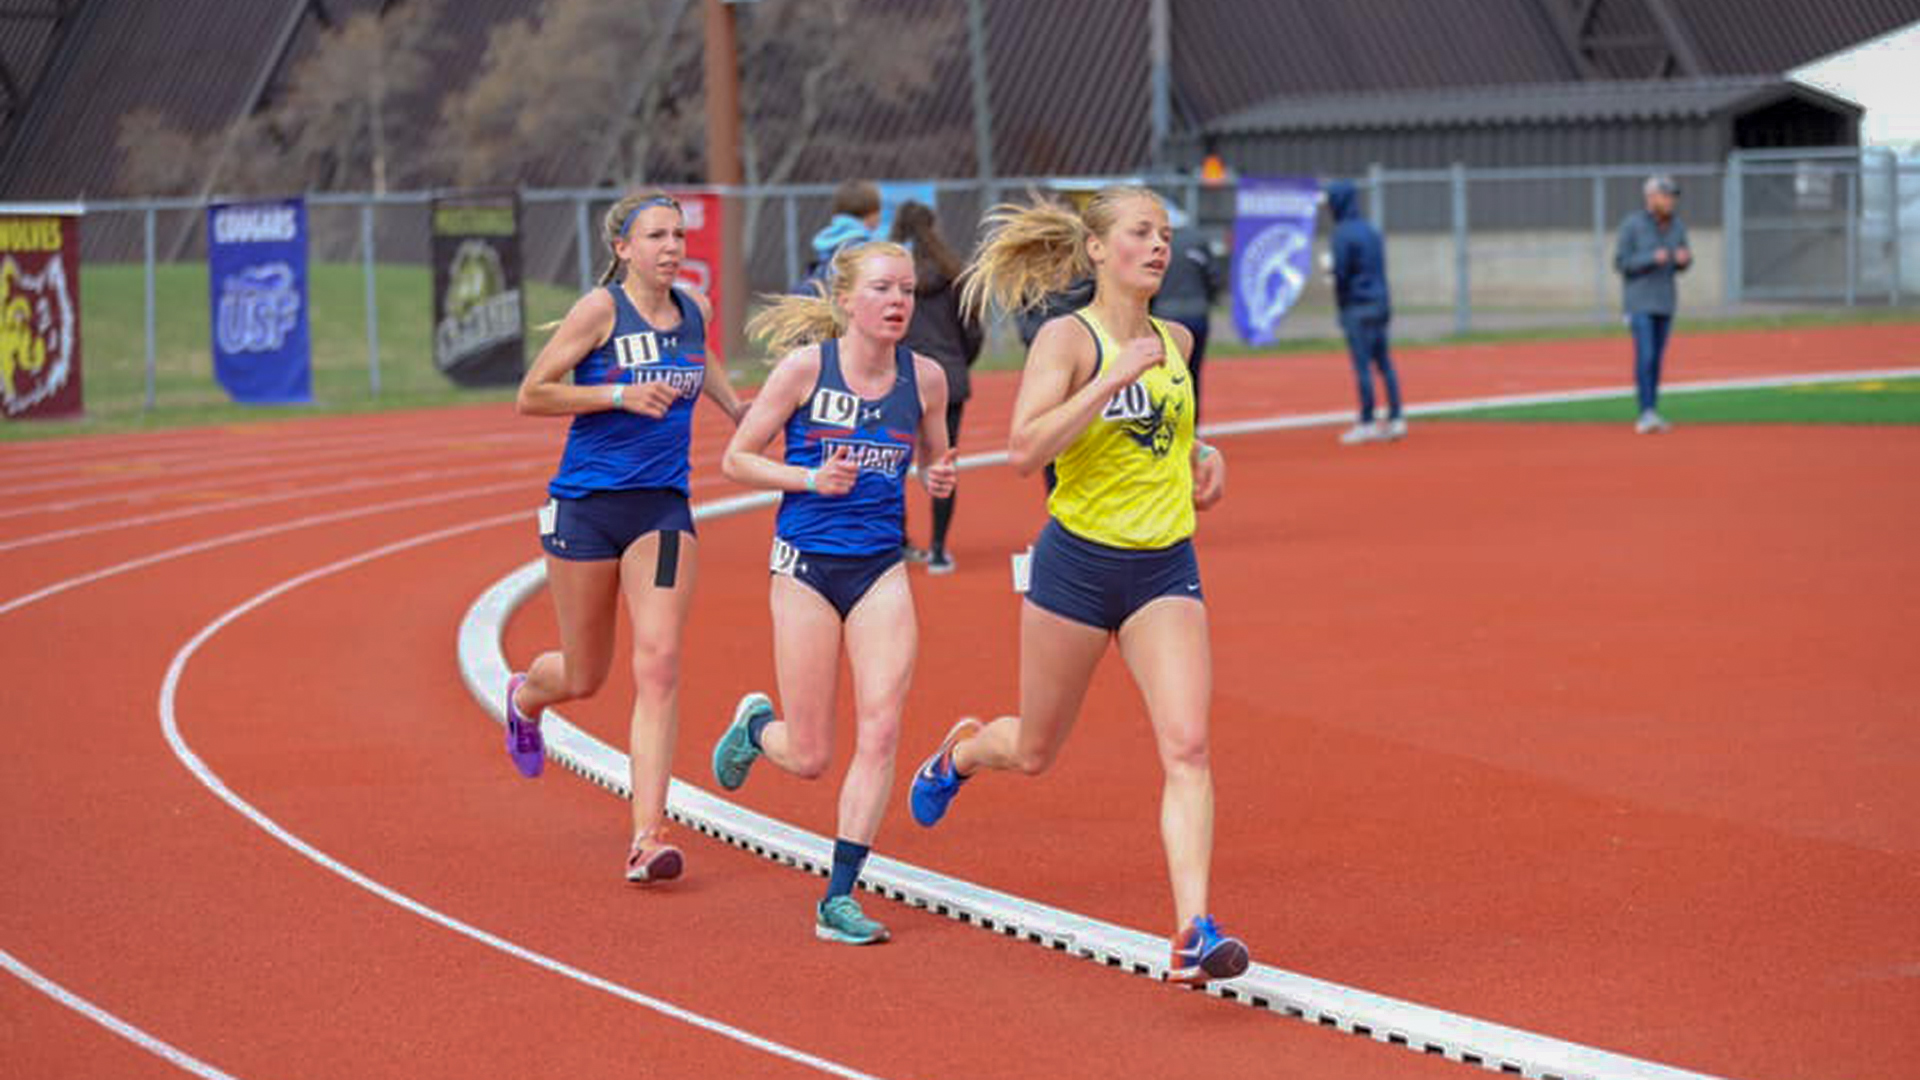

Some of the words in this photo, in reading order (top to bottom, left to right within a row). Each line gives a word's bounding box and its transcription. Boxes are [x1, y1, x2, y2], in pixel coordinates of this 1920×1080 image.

[620, 336, 654, 364] 11
[819, 390, 857, 422] 19
[1104, 383, 1145, 417] 20
